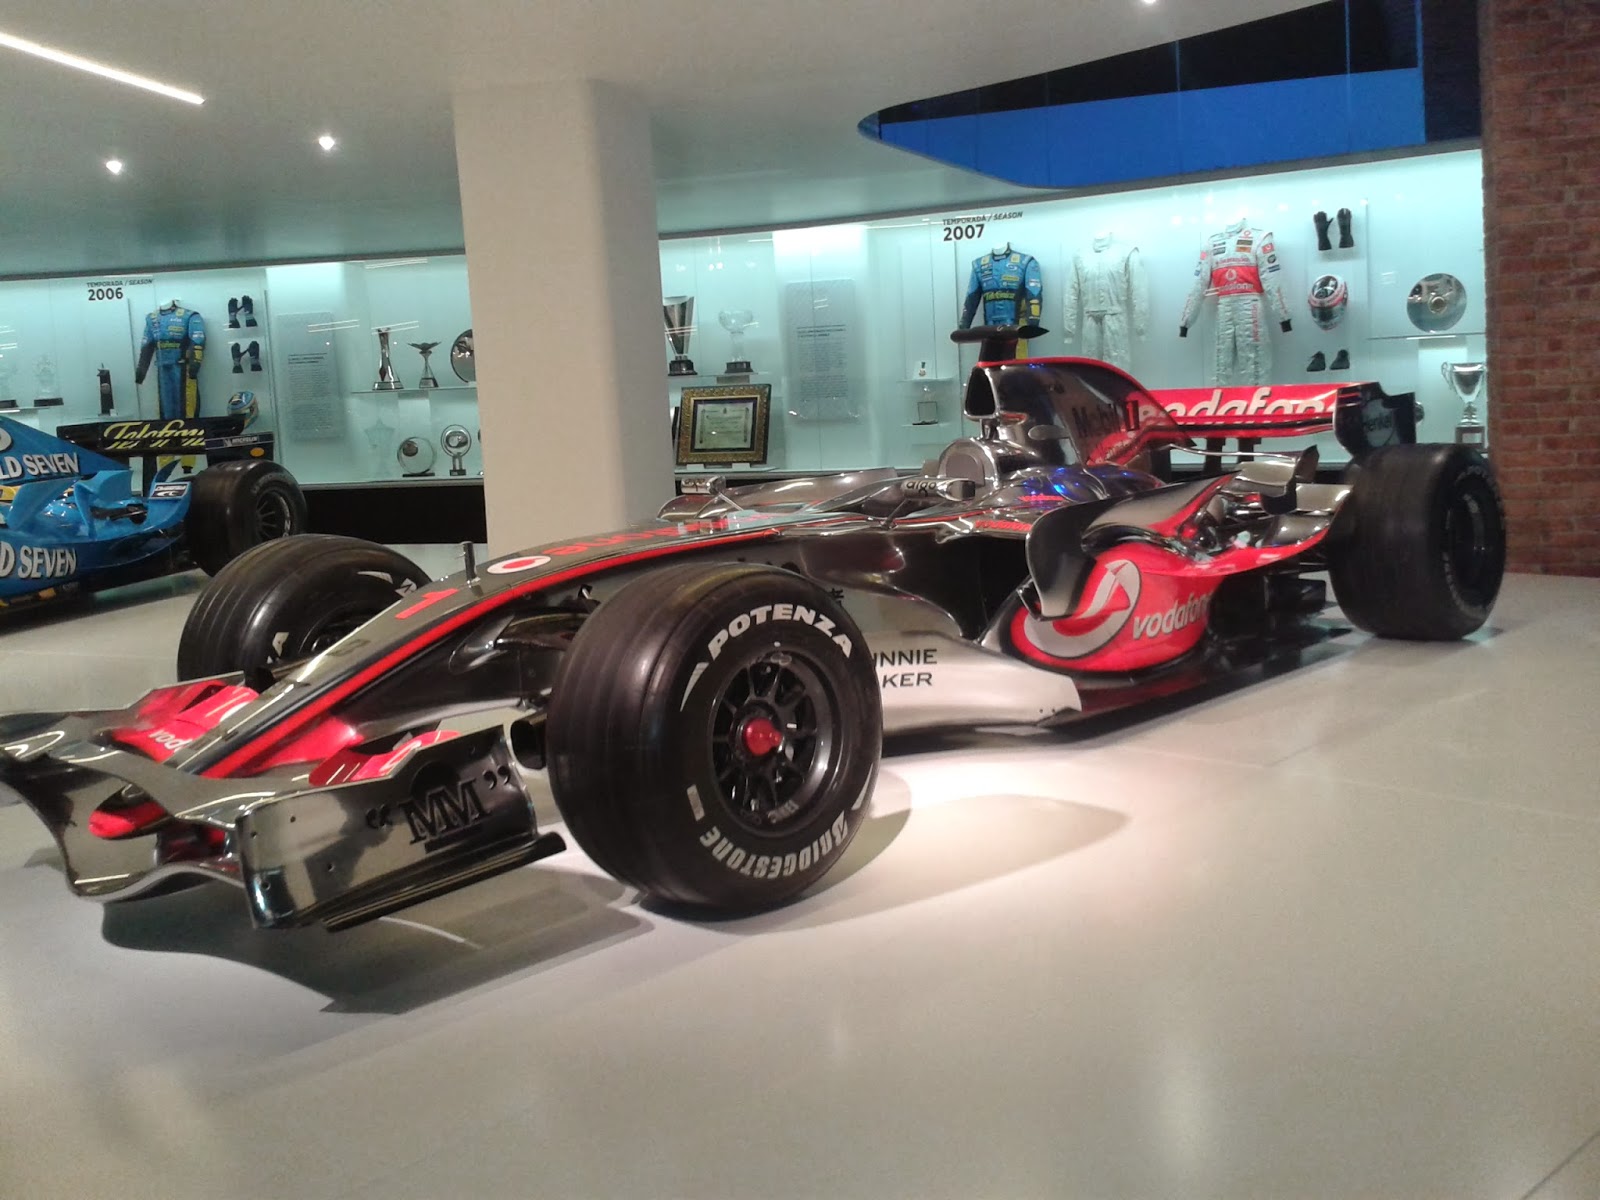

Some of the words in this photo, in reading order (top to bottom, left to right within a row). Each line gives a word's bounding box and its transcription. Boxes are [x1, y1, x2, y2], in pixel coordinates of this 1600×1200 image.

[943, 215, 987, 226] TEMPORADA
[994, 211, 1023, 221] SEASON
[943, 223, 985, 241] 2007
[88, 287, 123, 301] 2006
[129, 278, 154, 286] SEASON
[1164, 386, 1335, 425] odafon
[23, 452, 80, 476] SEVEN
[18, 544, 77, 579] SEVEN
[394, 588, 460, 620] 1
[1132, 589, 1213, 640] vodafon
[707, 603, 853, 661] POTENZA
[873, 648, 937, 668] NNIE
[882, 672, 933, 688] KER
[699, 810, 849, 879] BRIDGESTONE
